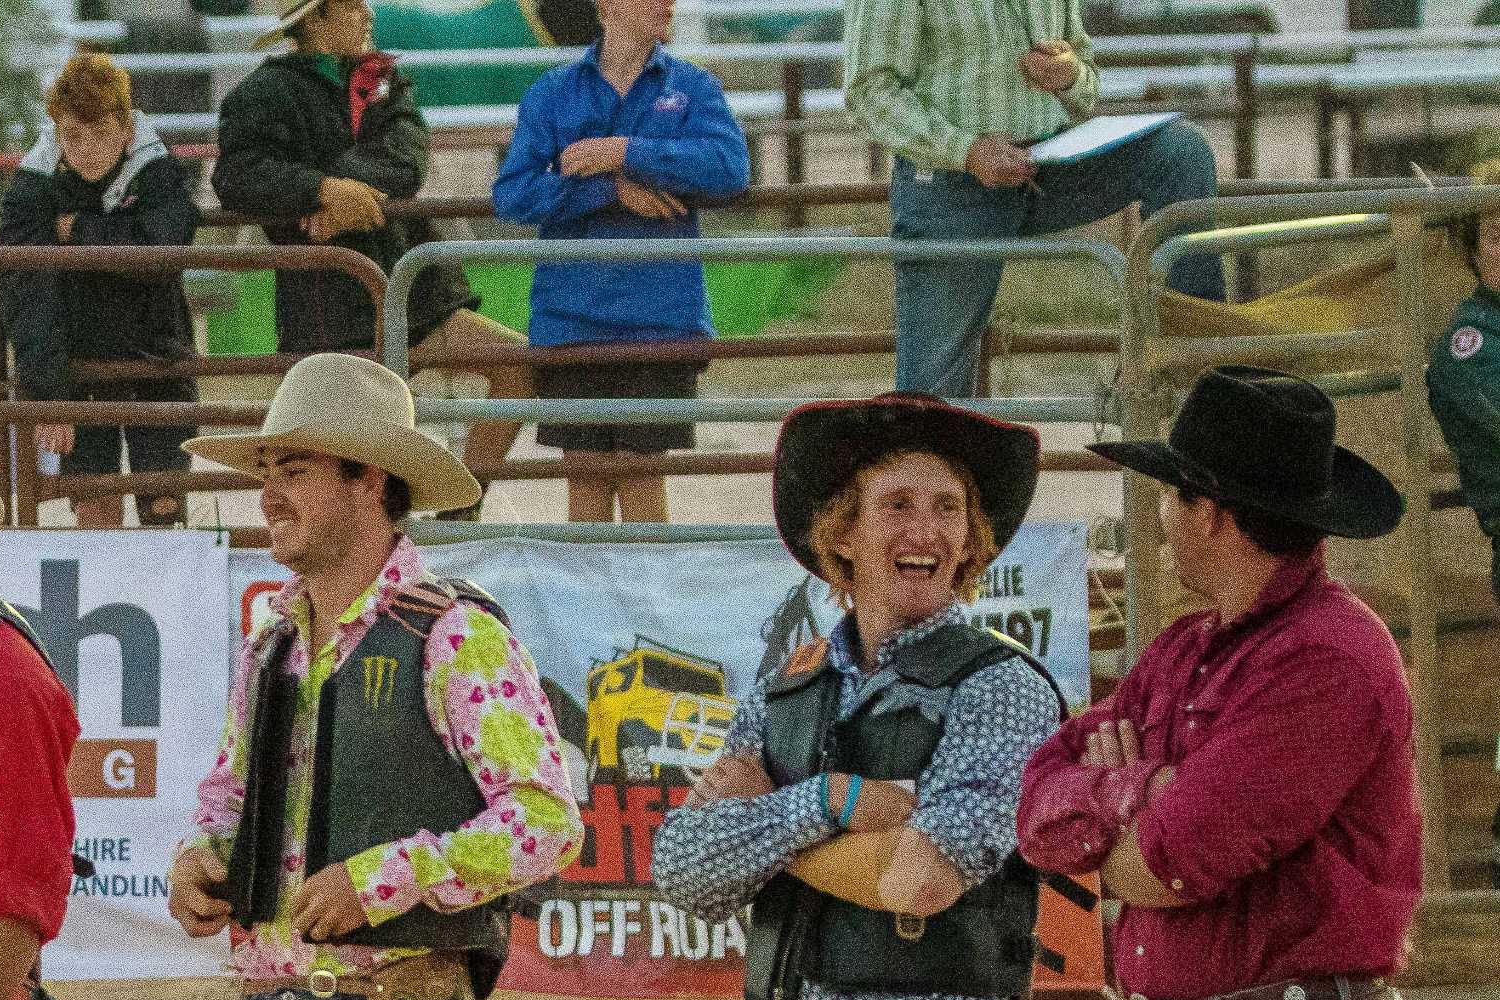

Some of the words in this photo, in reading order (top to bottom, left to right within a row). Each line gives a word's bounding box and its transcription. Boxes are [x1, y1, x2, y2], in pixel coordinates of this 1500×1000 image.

[74, 837, 131, 862] HIRE
[73, 875, 169, 898] ANDLIN
[538, 899, 641, 958] OFF
[650, 902, 750, 960] ROA
